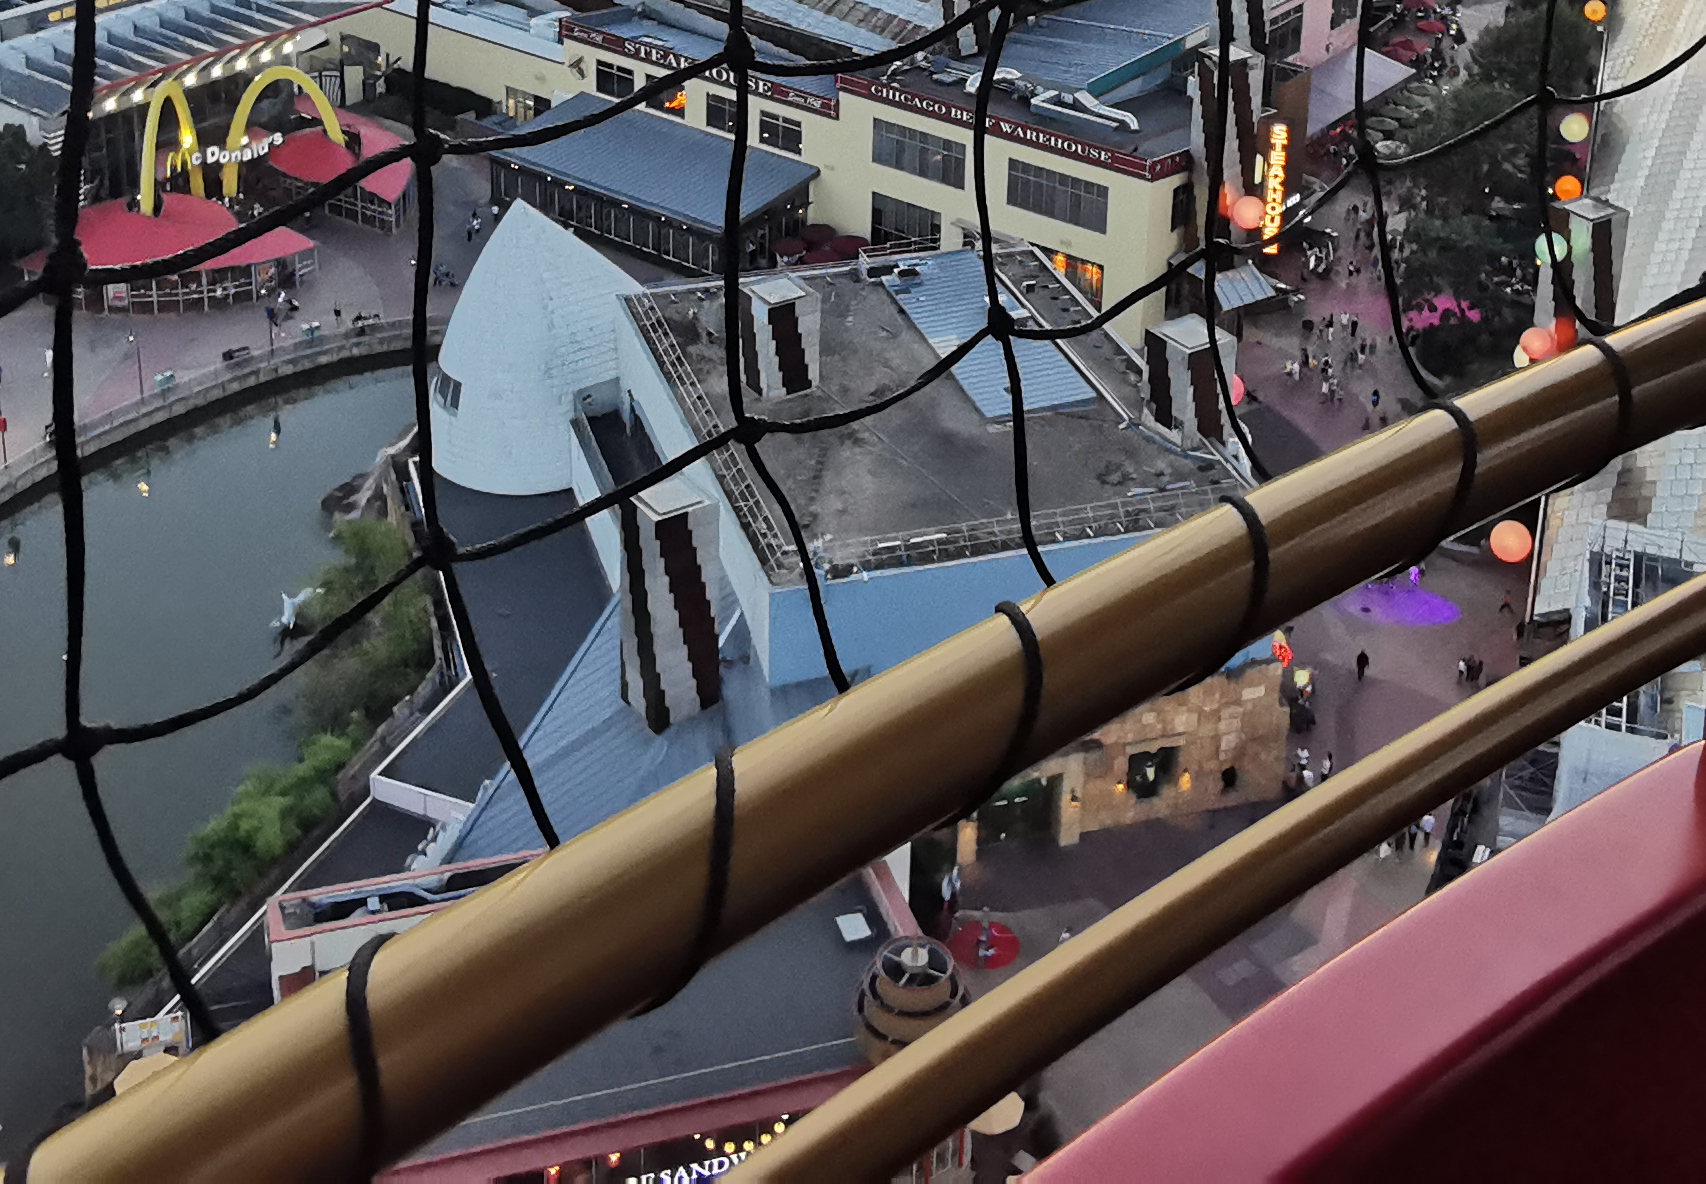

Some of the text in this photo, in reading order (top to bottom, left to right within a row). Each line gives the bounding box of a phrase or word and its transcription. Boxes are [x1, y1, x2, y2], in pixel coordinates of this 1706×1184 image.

[624, 40, 773, 97] STEAKOUSE
[870, 84, 1112, 163] CHICAGO BEF WAREHOUSE
